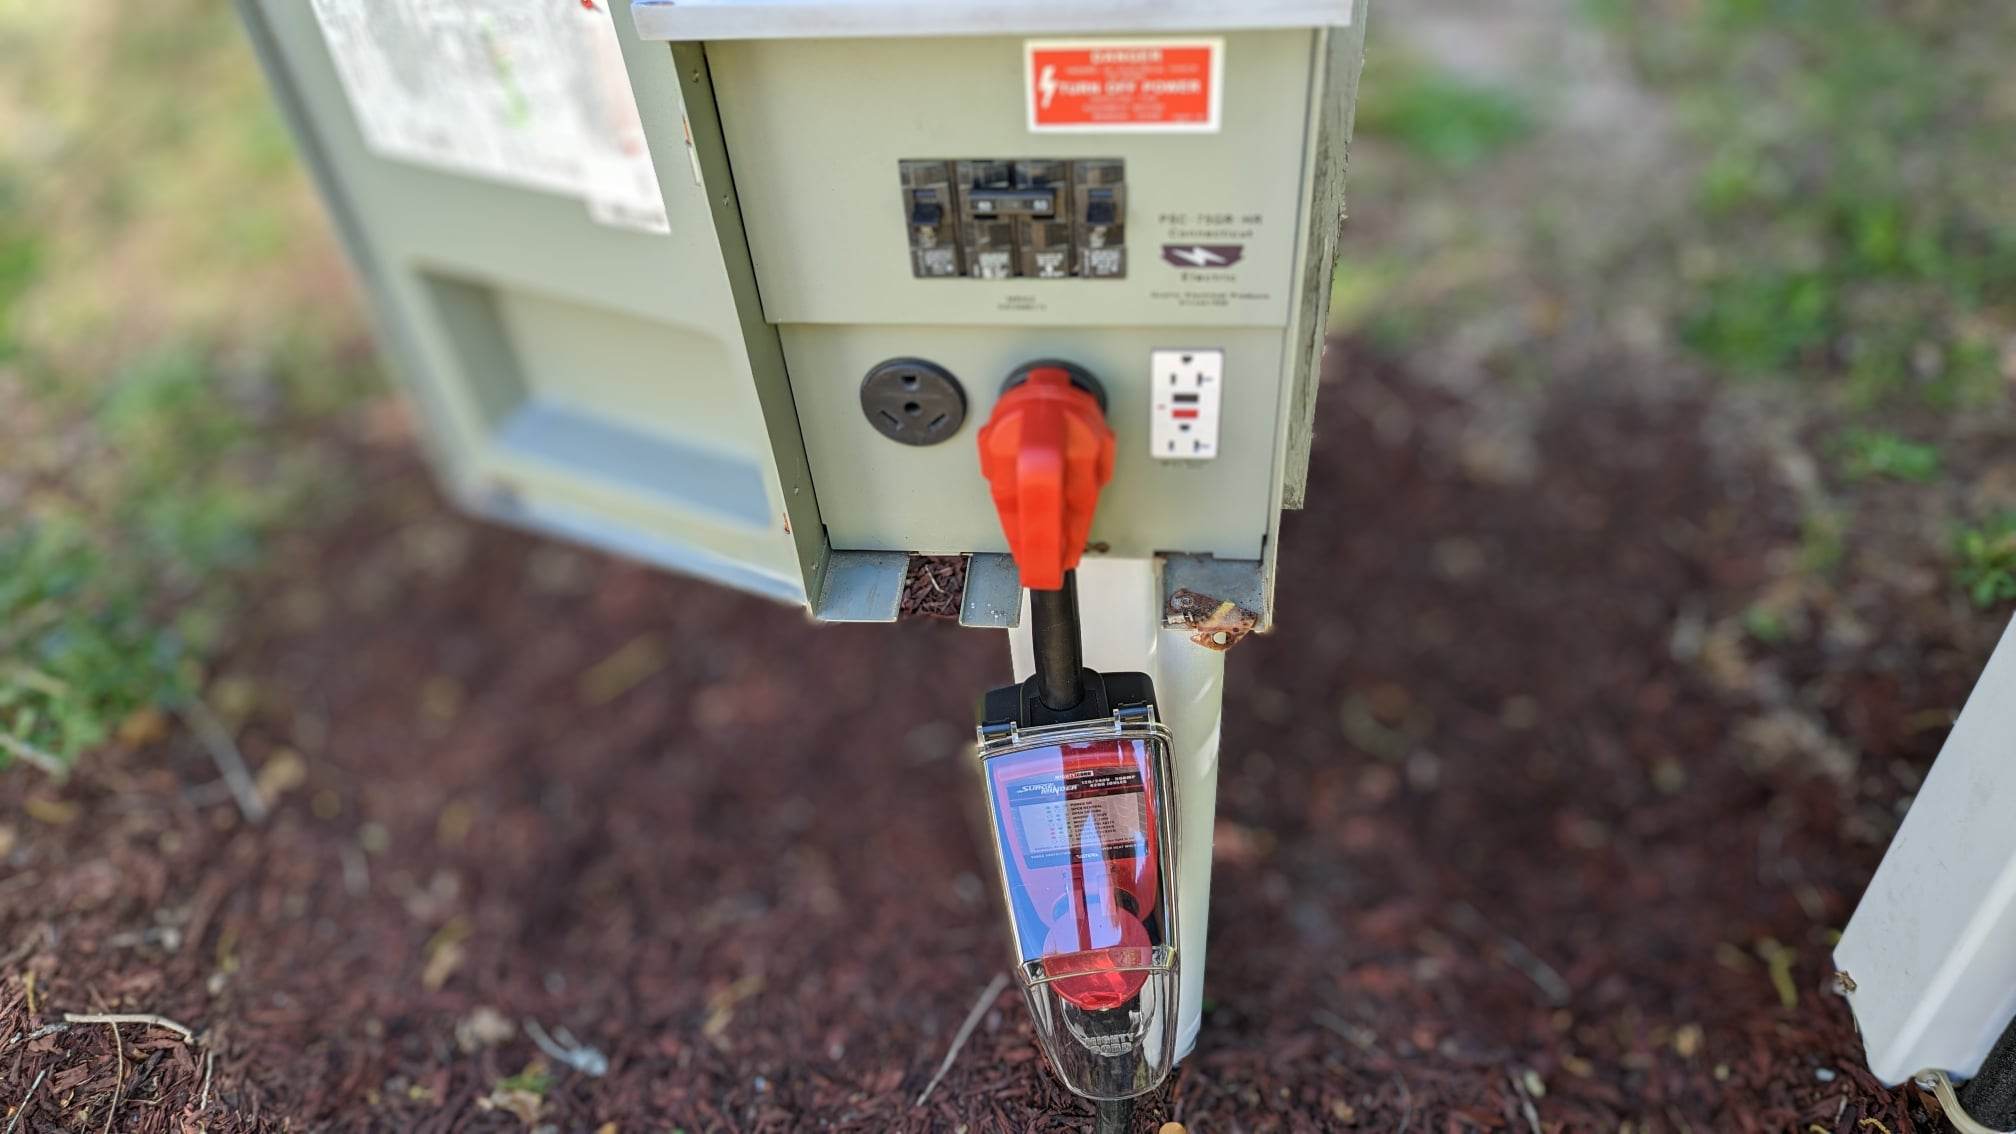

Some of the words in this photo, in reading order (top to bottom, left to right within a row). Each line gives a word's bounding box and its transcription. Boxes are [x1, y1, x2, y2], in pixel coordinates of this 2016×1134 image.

[1058, 82, 1100, 96] TURN
[1105, 81, 1136, 95] OFF
[1142, 79, 1201, 94] POWER
